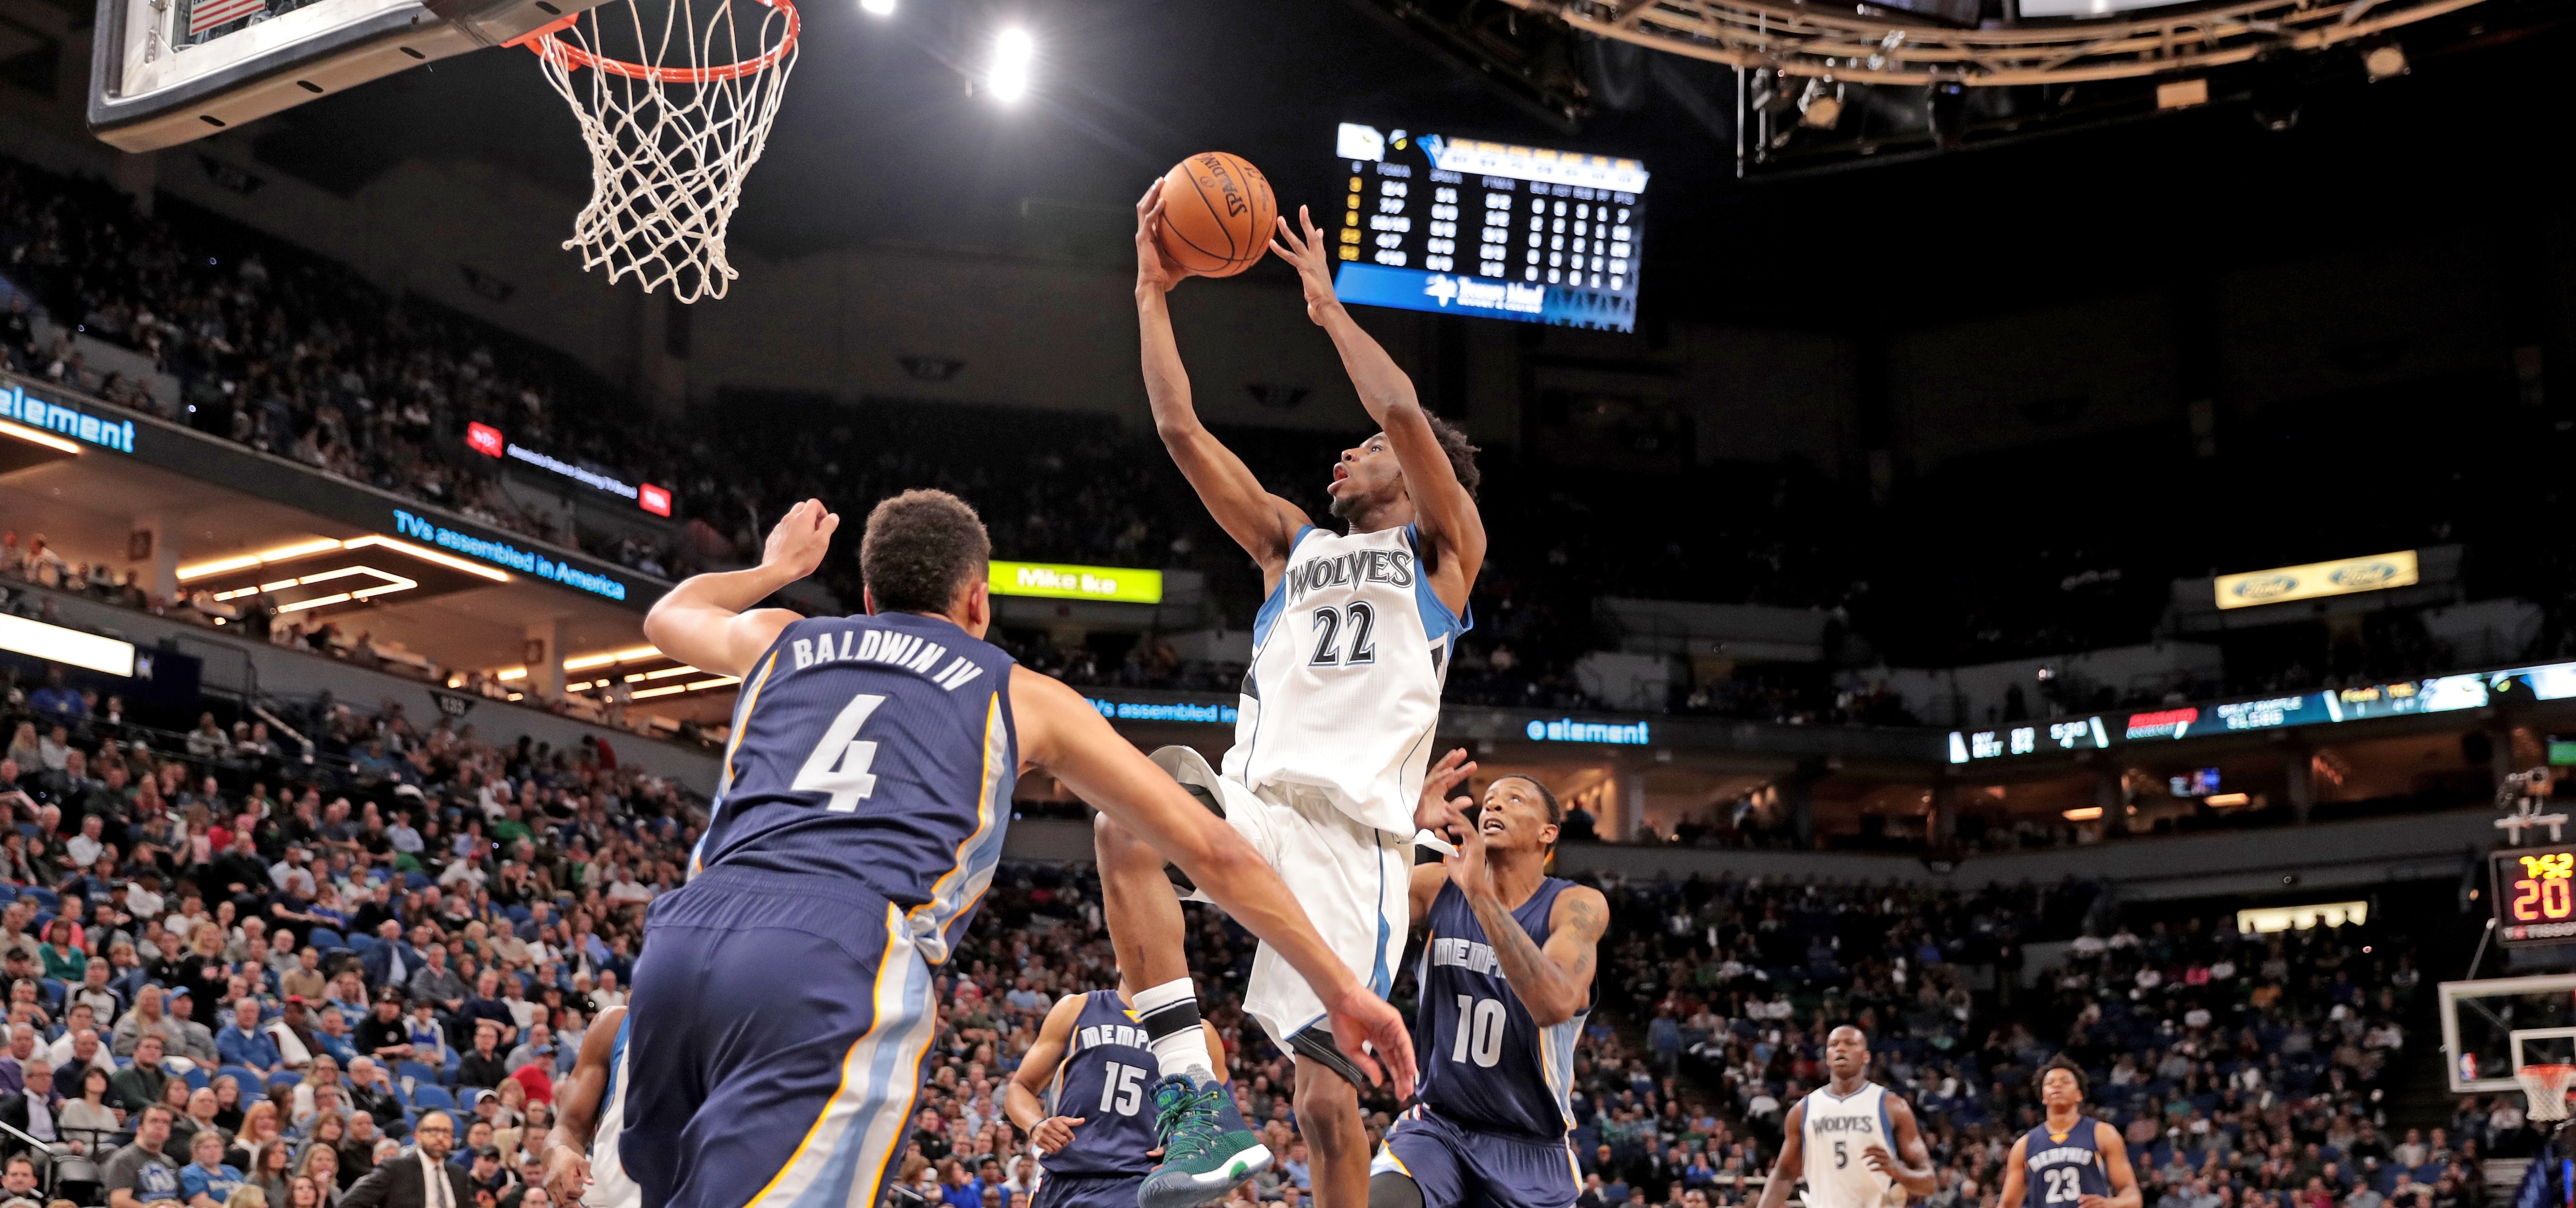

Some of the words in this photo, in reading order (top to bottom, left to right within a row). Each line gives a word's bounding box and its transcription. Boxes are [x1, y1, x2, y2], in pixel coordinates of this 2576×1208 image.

[394, 509, 434, 541] TVs
[435, 528, 535, 573] assembled
[536, 555, 554, 579] in
[554, 561, 625, 600] America
[1018, 567, 1077, 589] Mike
[1286, 549, 1414, 607] WOLVES
[1309, 601, 1375, 666] 22
[793, 630, 946, 674] BALDWIN
[933, 657, 984, 691] IV
[1117, 702, 1217, 722] assembled
[1221, 705, 1238, 723] in
[1547, 717, 1649, 744] element
[791, 694, 886, 812] 4
[2513, 878, 2571, 920] 20
[1452, 994, 1506, 1068] 10
[1099, 1061, 1147, 1117] 15
[1812, 1115, 1873, 1139] WOLVES
[1834, 1140, 1848, 1169] 5
[2028, 1147, 2093, 1173] MEMPHIS
[2043, 1167, 2081, 1204] 23
